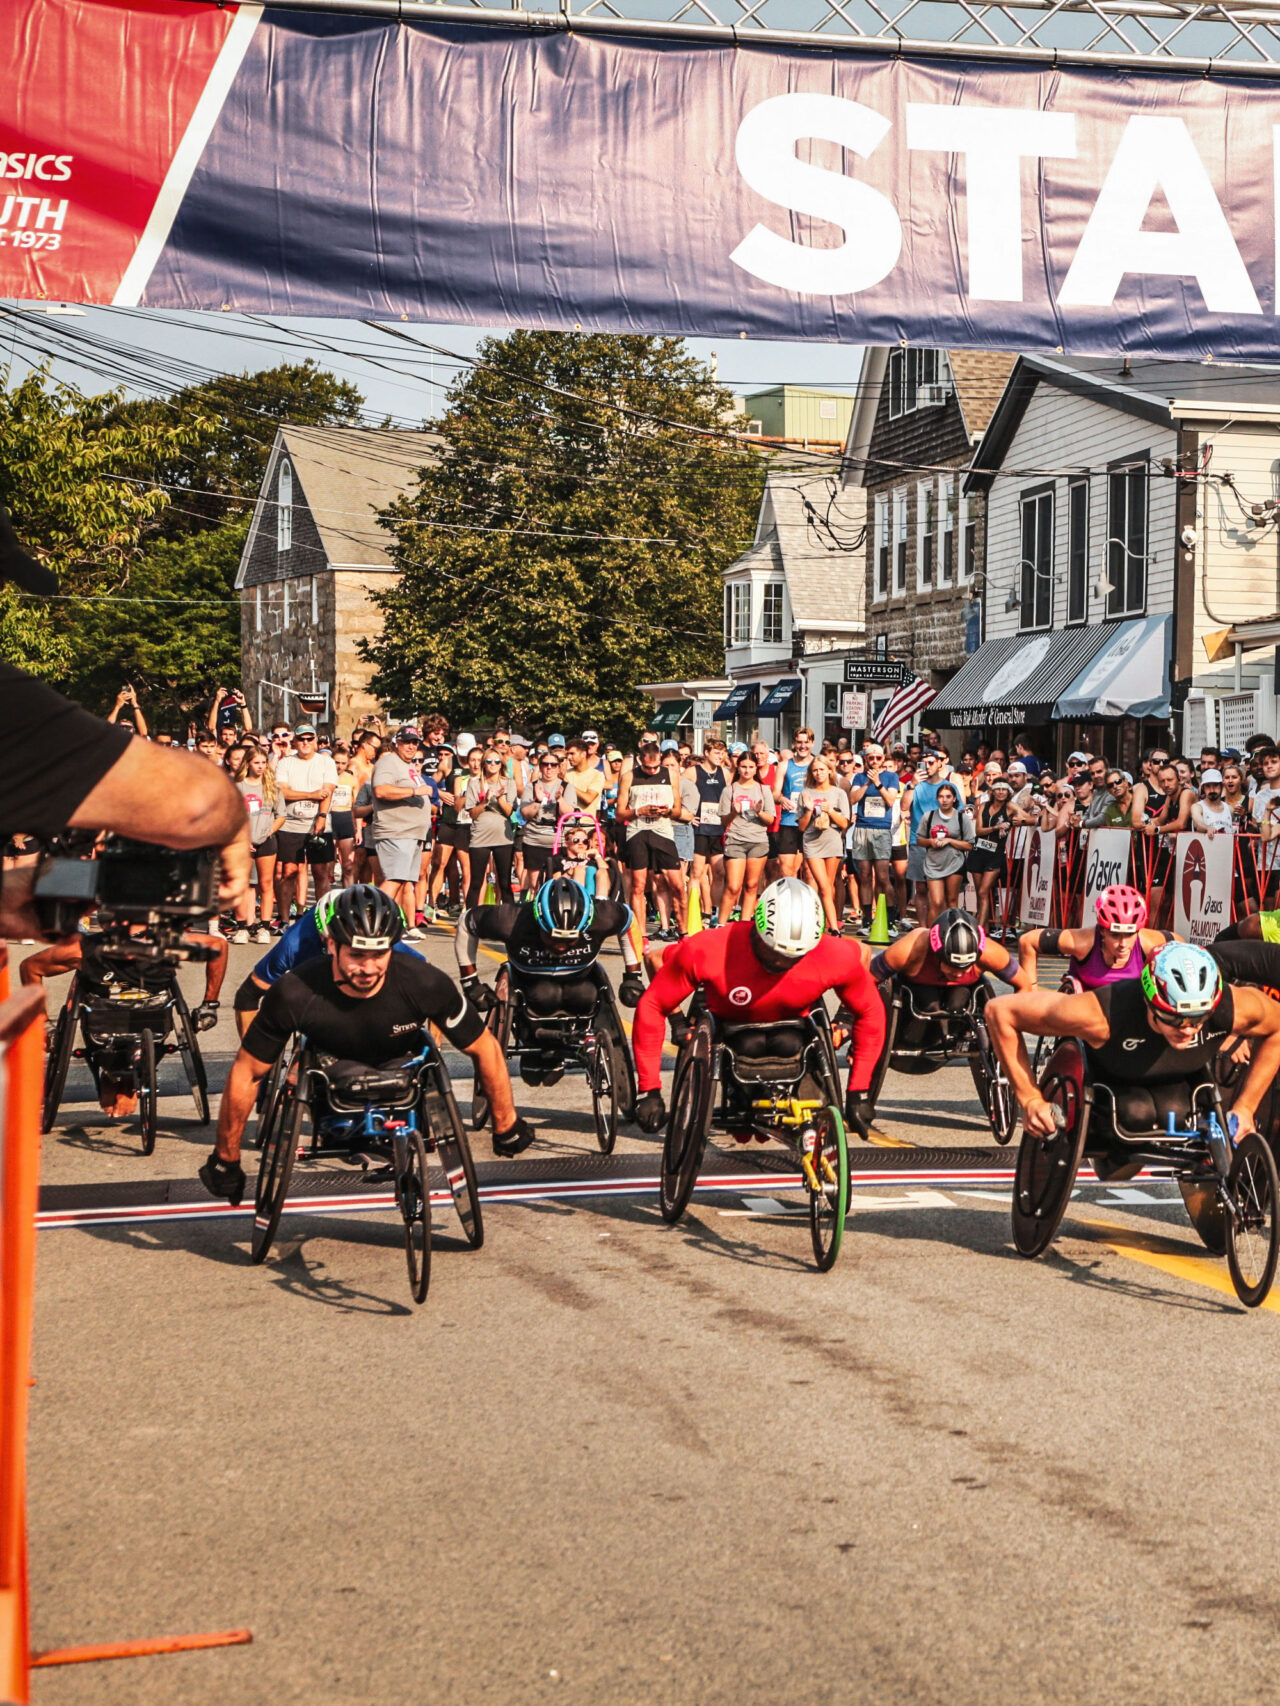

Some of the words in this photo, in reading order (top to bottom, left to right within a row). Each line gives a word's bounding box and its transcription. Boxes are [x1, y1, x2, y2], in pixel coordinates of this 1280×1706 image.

[10, 230, 62, 250] 1973
[755, 903, 764, 931] W10
[766, 898, 776, 938] KASK
[1190, 919, 1221, 938] FALMOUTH
